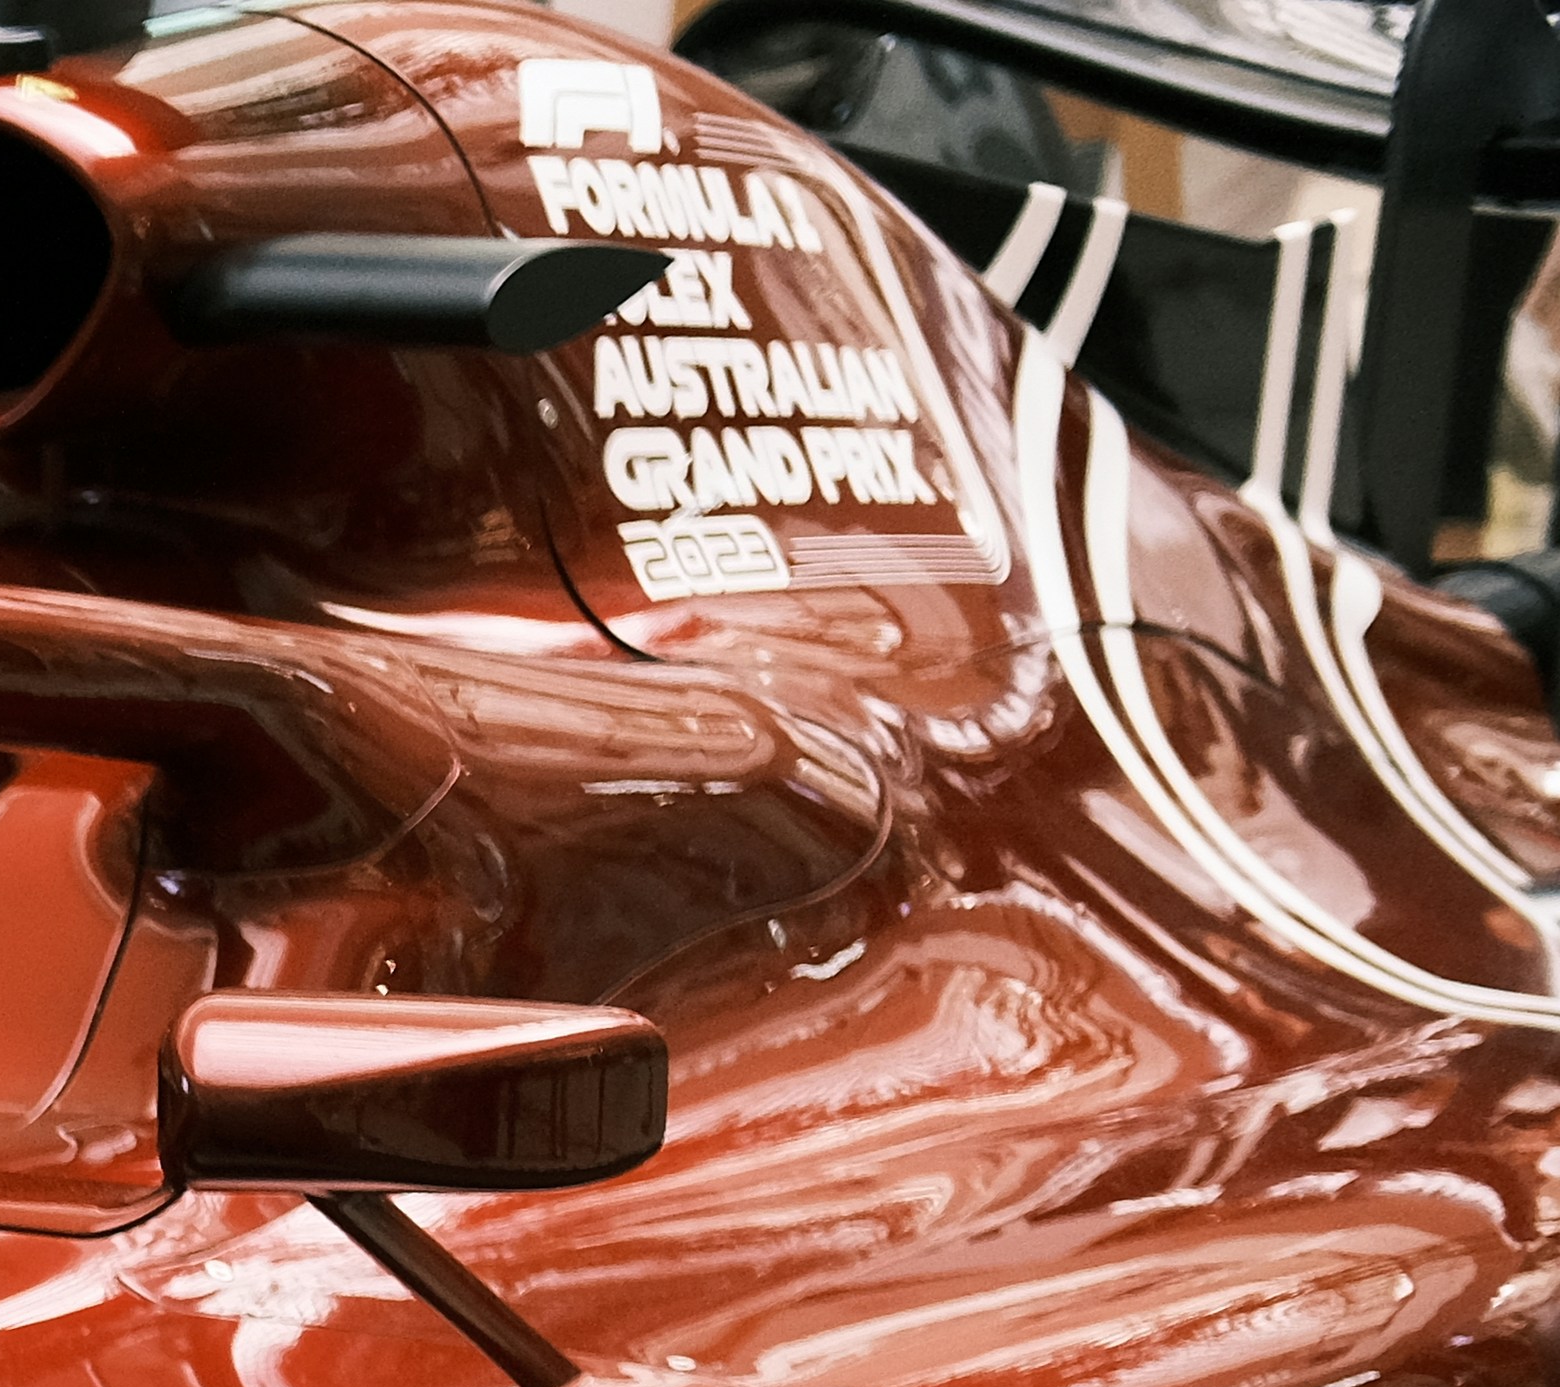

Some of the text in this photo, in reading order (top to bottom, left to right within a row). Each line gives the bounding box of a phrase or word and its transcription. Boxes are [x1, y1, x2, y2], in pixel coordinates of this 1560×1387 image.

[526, 155, 794, 250] FORMULA
[603, 247, 753, 331] LEX
[593, 334, 920, 423] AUSTRALIAN
[603, 425, 940, 512] GRAND PRIX
[616, 514, 792, 603] 2023
